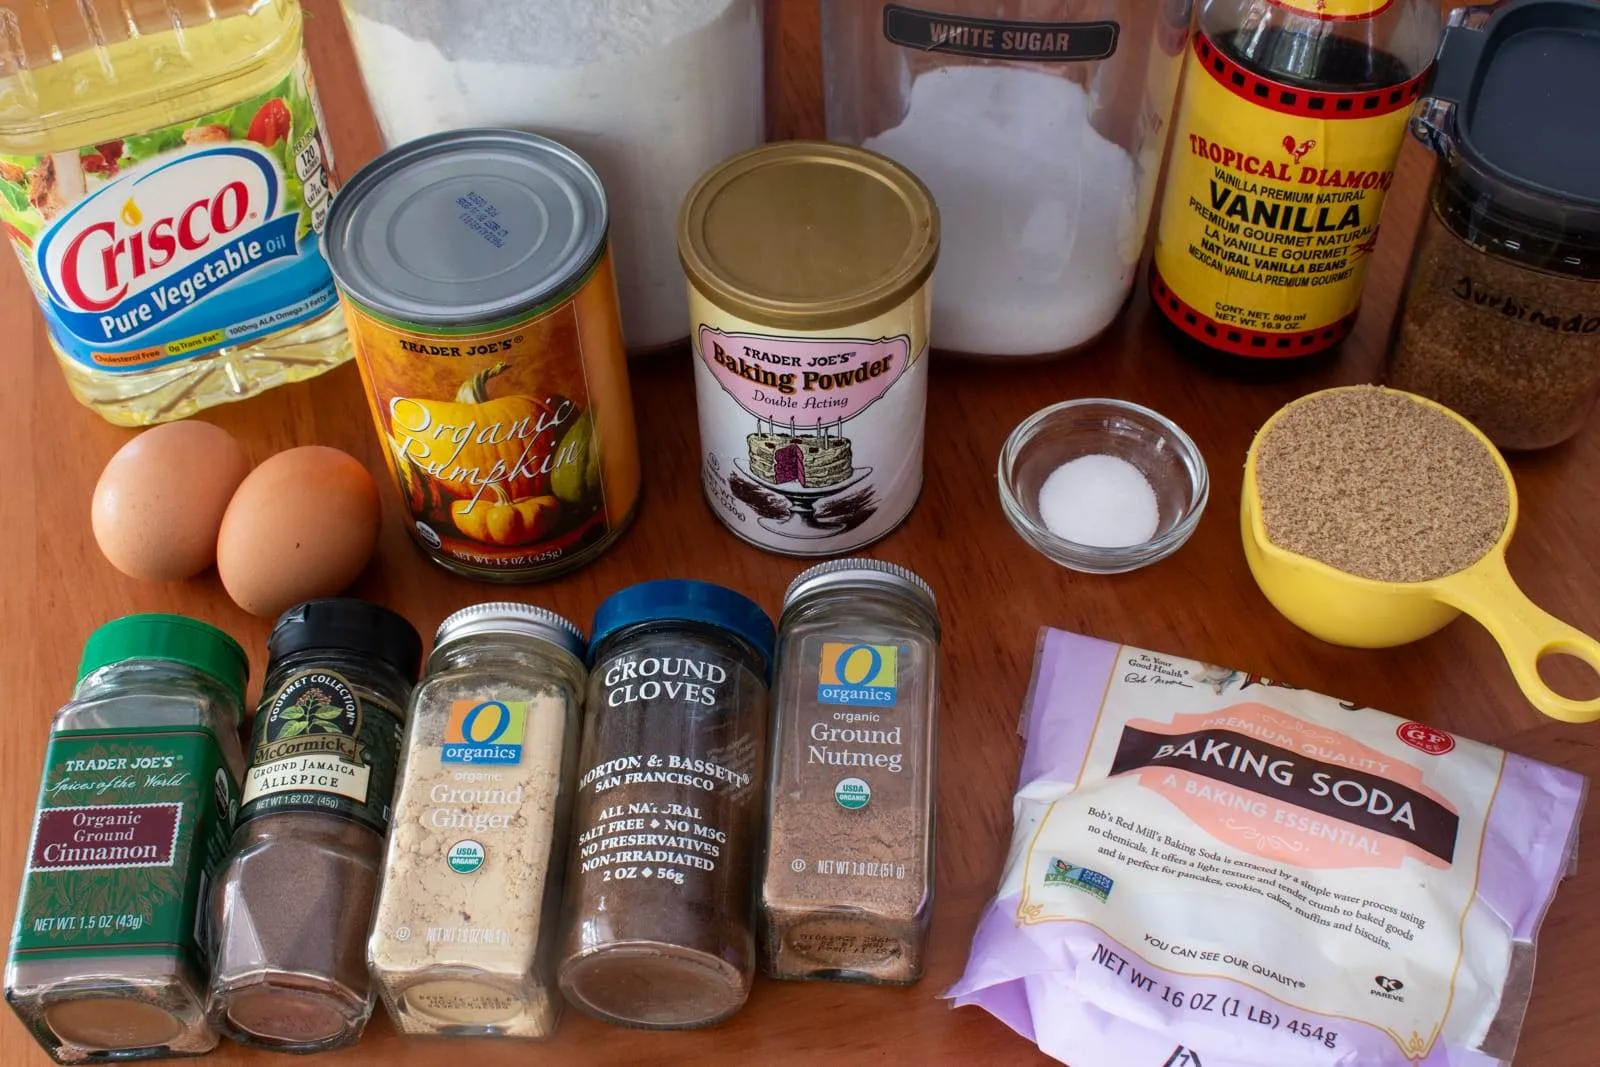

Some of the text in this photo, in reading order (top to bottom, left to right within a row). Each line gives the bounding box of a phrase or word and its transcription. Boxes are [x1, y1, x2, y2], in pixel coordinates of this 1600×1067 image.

[930, 23, 1070, 51] WHITE SUGAR
[301, 145, 315, 167] 120
[1189, 134, 1393, 192] TROPICAL DIAMON
[1214, 166, 1365, 204] VAINILLA PREMIUM NATURAL
[1209, 178, 1360, 233] VANILLA
[1188, 196, 1373, 247] PREMIUM GOURMET NATURAL
[1204, 225, 1350, 260] LA VANILLE GOURMET
[1188, 243, 1353, 287] MEXICAN VANILLA PREMIUM GOURMET
[1201, 238, 1347, 274] NATURAL VANILLA BEANS
[100, 234, 287, 338] Pure Vegetable Oil
[259, 302, 309, 326] ALA Omega-3
[1215, 302, 1244, 315] CONT.
[142, 349, 160, 361] Free
[179, 339, 203, 350] Trans
[400, 339, 461, 357] TRADER
[743, 345, 802, 367] TRADER
[713, 340, 894, 395] Baking Powder
[752, 389, 849, 410] Double Acting
[390, 395, 576, 458] Organic
[390, 431, 578, 515] Pumpkin
[452, 547, 563, 566] NET 15 (425g)
[604, 656, 727, 687] GROUND
[1128, 659, 1152, 671] Good
[270, 676, 308, 722] GOURMET
[607, 681, 717, 708] CLOVES
[822, 686, 892, 702] organics
[833, 711, 880, 723] organic
[810, 722, 902, 745] Ground
[1200, 716, 1295, 748] PREMIUM
[1301, 742, 1391, 774] QUALITY
[256, 736, 347, 763] McCormick
[446, 744, 516, 762] organics
[807, 745, 903, 773] Nutmeg
[65, 758, 127, 772] TRADER
[253, 759, 355, 780] GROUND JAMAICA
[454, 770, 502, 782] organic
[578, 754, 643, 792] MORTON
[646, 754, 663, 767] &
[45, 772, 190, 798] Spices World
[259, 775, 340, 791] ALLSPICE
[429, 783, 523, 805] Ground
[595, 771, 715, 793] SAN FRANCISCO
[842, 784, 864, 793] USDA
[1152, 737, 1416, 831] BAKING SODA
[284, 794, 339, 809] 1.62 (45g)
[598, 804, 625, 822] ALL
[72, 810, 142, 829] Organic
[431, 807, 514, 833] Ginger
[1162, 773, 1381, 857] A BAKING ESSENTIAL
[73, 828, 135, 843] Ground
[578, 818, 727, 846] SALT FREE NO MSG
[43, 843, 157, 863] Cinnamon
[455, 847, 478, 856] USDA
[580, 834, 720, 859] NO PRESERVATIVES
[451, 857, 480, 866] ORGANIC
[581, 850, 715, 874] NON-IRRADIATED
[817, 860, 879, 877] NET WT OZ
[1087, 806, 1426, 930] Bob's Red Mill's Baking Soda extracted simple water process using
[602, 866, 685, 885] 2 OZ 56g
[1087, 824, 1415, 942] no chemicals. offers light texture and tender crumb baked goods
[1097, 845, 1392, 950] and perfect for pancakes, cookies, cakes, muffins and biscuits.
[33, 914, 143, 932] NET WT. 1.5 OZ (43g)
[1144, 933, 1172, 953] YOU
[1171, 945, 1198, 959] CAN
[1199, 951, 1220, 962] SEE
[1223, 954, 1249, 970] OUR
[1090, 943, 1339, 1049] NET WT 16 OZ (1 LB) 454g
[1370, 989, 1405, 1003] PAREVE
